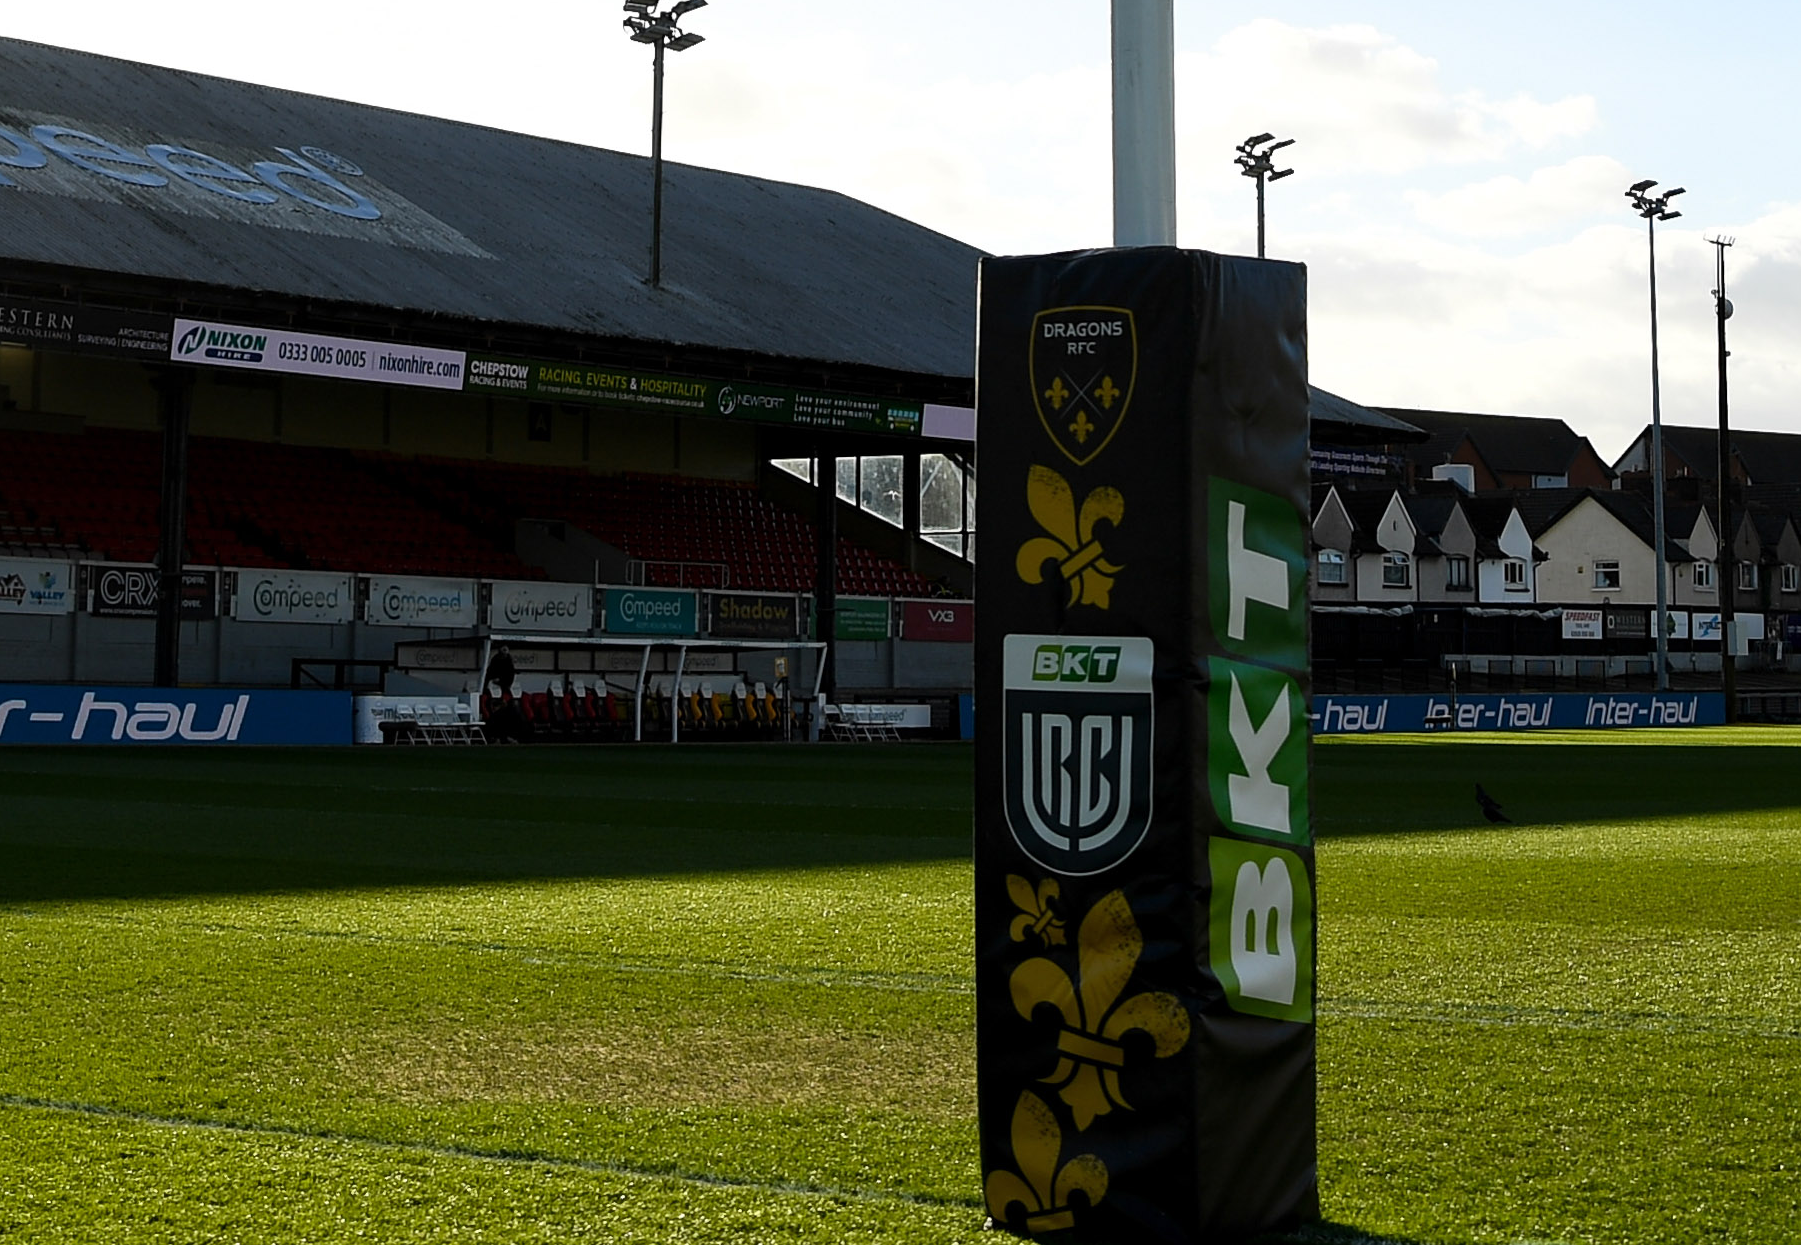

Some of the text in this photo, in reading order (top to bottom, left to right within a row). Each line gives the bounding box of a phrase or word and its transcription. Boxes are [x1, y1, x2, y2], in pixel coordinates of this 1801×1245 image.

[118, 327, 169, 341] ARCHITECTURE
[207, 330, 267, 352] NIXON
[1044, 321, 1123, 337] DRAGONS
[279, 342, 460, 378] 0333 005 0005 nixonhire.com
[1067, 342, 1096, 355] RFC
[470, 359, 529, 380] CHEPSTOW
[586, 372, 627, 390] EVENTS
[630, 377, 638, 390] &
[640, 379, 707, 398] HOSPITALITY
[737, 394, 786, 409] NEWPORT
[30, 591, 65, 600] VALLEY
[254, 580, 338, 615] Compeed
[383, 586, 461, 619] Compeed
[619, 593, 681, 622] Compeed
[719, 597, 790, 619] Shadow
[504, 596, 577, 623] Compeed
[928, 609, 954, 623] VX3
[1035, 651, 1117, 676] BKT
[1312, 699, 1388, 731] -haul
[1585, 696, 1697, 726] Inter-haul
[1229, 500, 1296, 1005] BKT
